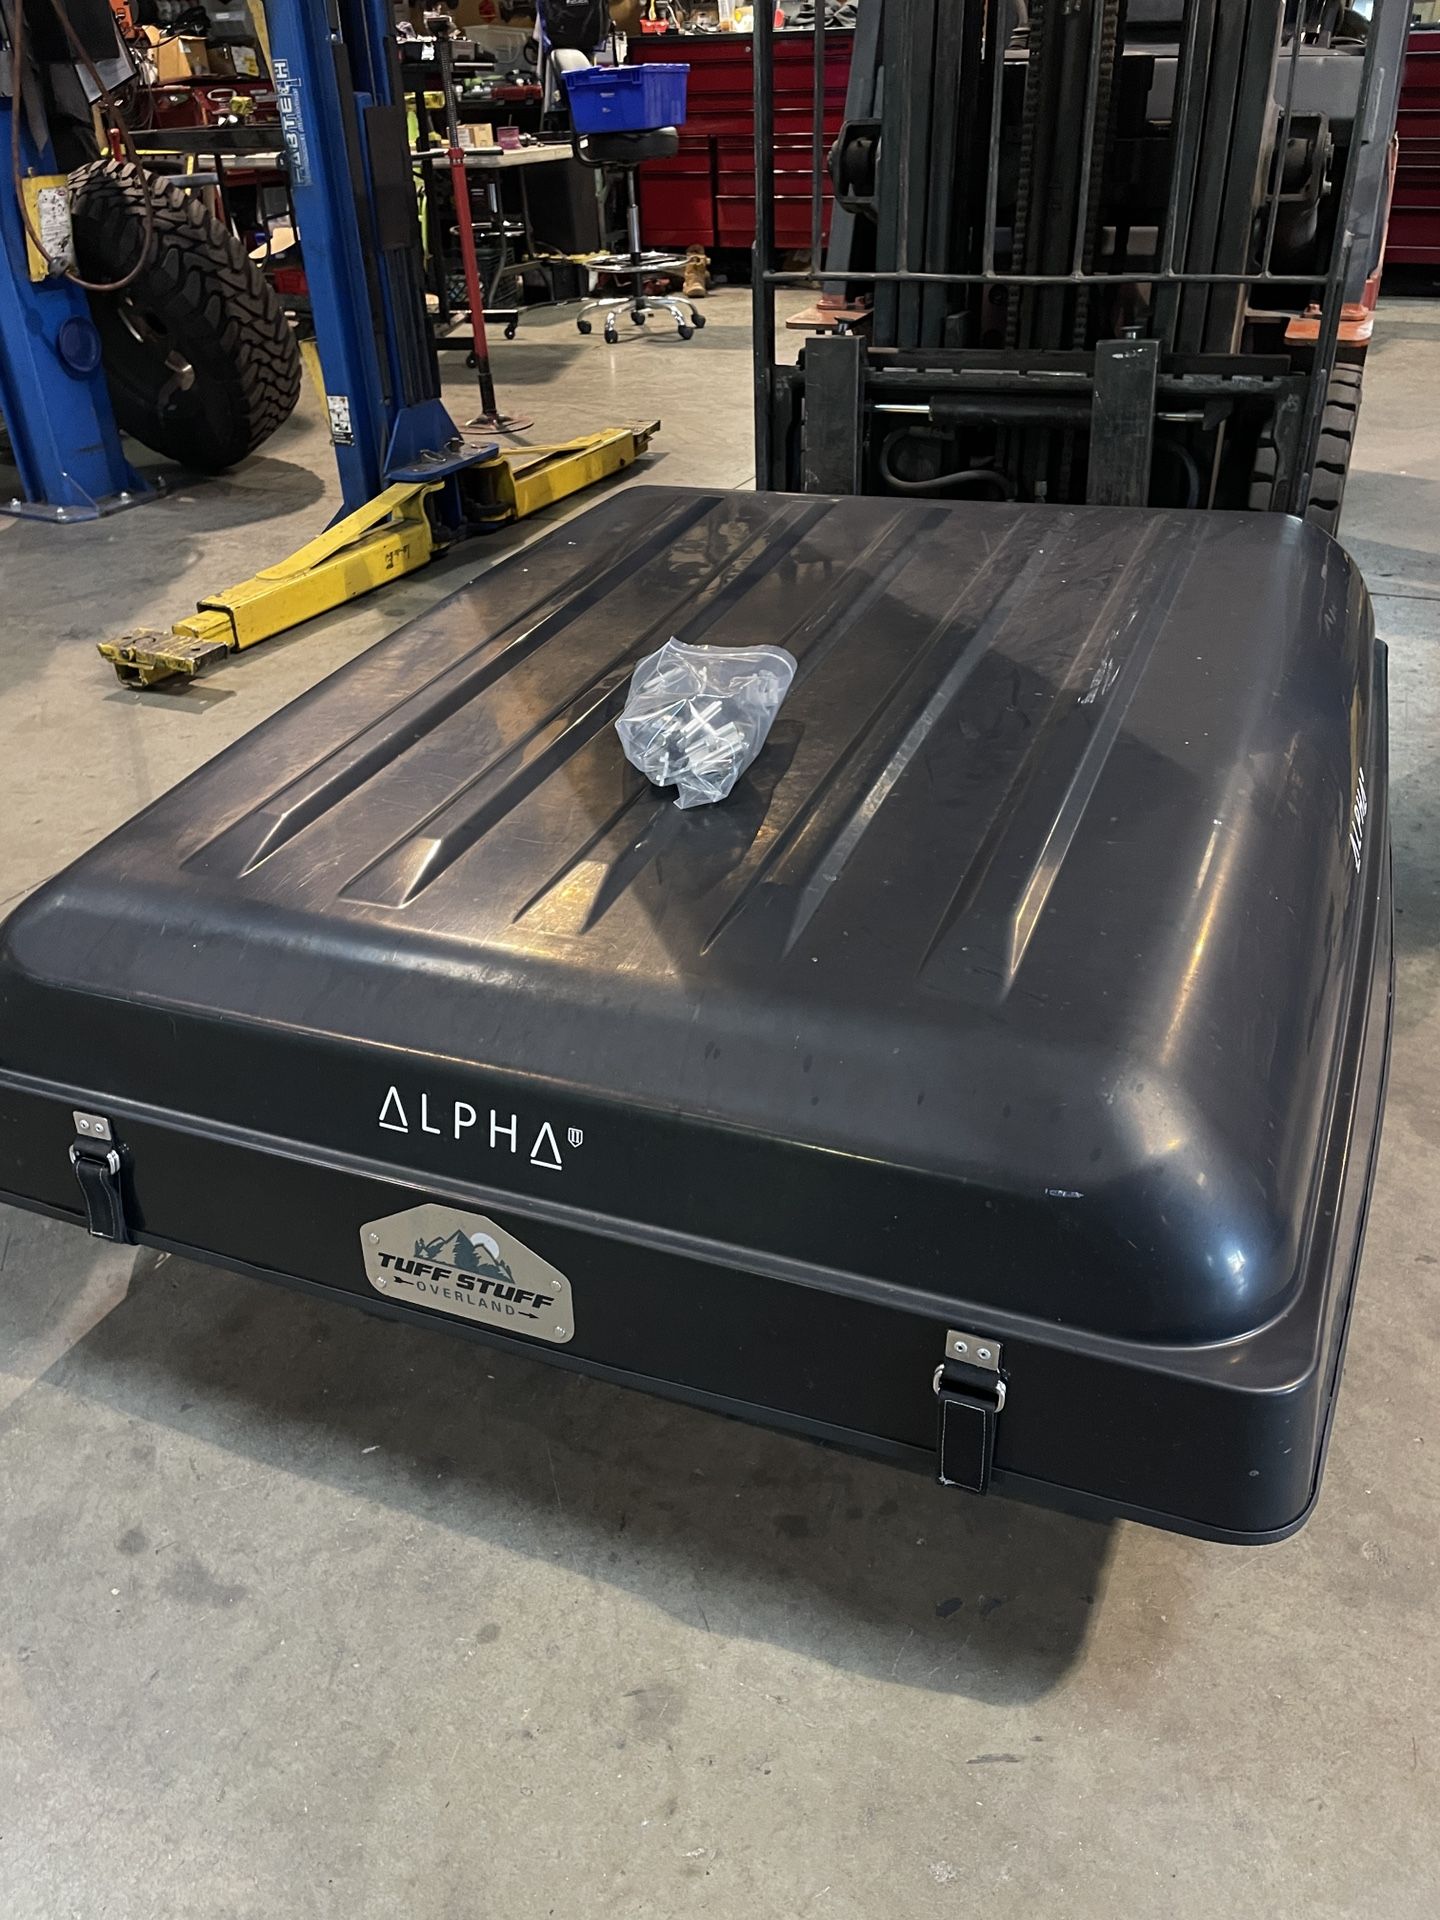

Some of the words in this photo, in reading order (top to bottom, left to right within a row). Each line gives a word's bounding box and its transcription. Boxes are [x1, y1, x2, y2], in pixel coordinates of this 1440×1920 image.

[378, 1085, 562, 1170] ALPHA
[378, 1252, 452, 1282] TUFF
[456, 1272, 555, 1310] STUFF
[416, 1281, 516, 1316] OVERLAND
